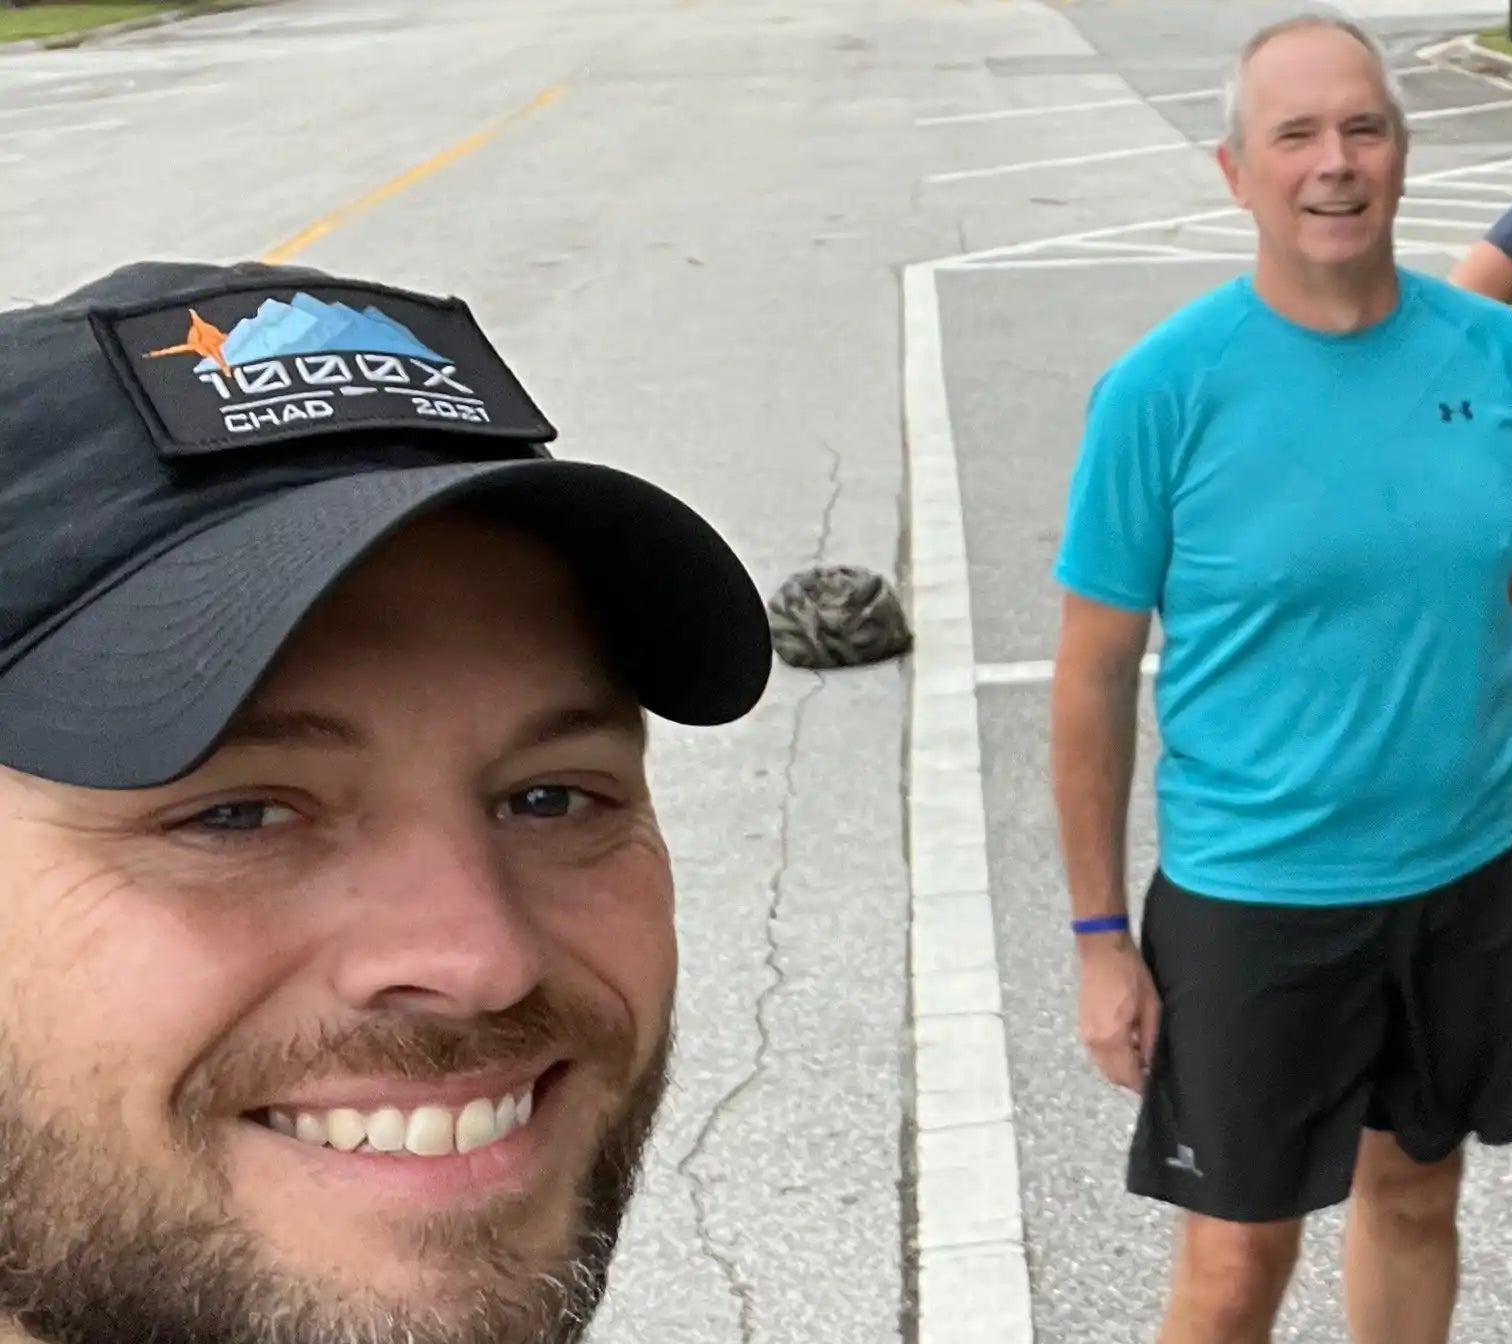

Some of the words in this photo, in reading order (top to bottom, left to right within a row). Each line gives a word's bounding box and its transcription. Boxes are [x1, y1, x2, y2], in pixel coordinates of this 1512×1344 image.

[198, 353, 474, 401] 1000X
[224, 401, 335, 432] CHAD
[415, 400, 490, 423] 2021
